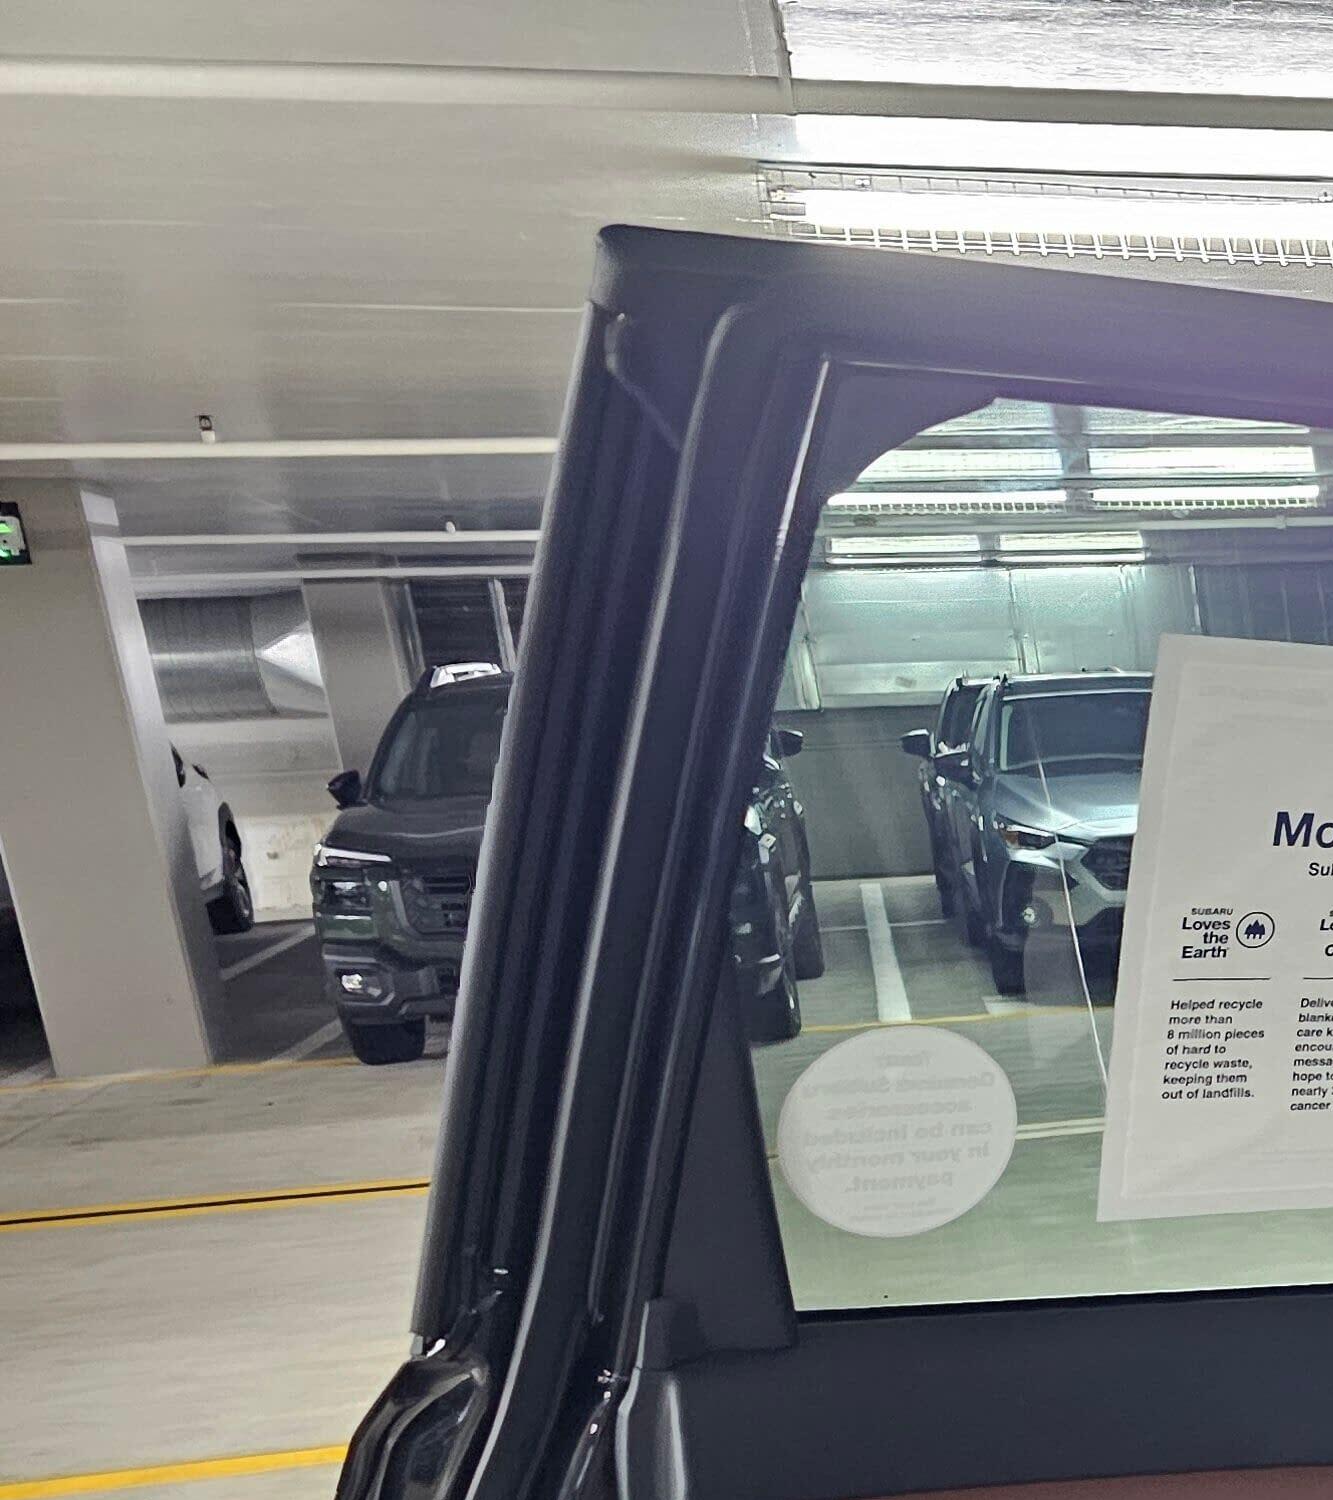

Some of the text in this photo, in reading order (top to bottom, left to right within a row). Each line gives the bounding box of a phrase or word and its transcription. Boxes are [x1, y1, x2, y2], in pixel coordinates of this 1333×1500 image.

[1182, 917, 1230, 930] Loves
[1203, 931, 1228, 944] the
[1182, 946, 1226, 958] Earth
[1171, 999, 1262, 1011] Helped recycle
[1206, 1015, 1232, 1024] than
[1167, 1029, 1264, 1041] 8 million pieces
[1297, 1029, 1323, 1037] care
[1167, 1044, 1226, 1055] of hard to
[1165, 1059, 1252, 1071] recycle waste,
[1163, 1074, 1247, 1086] keeping them
[1293, 1072, 1322, 1083] hope
[1162, 1088, 1254, 1099] out of landfills.
[1292, 1087, 1328, 1098] nearly
